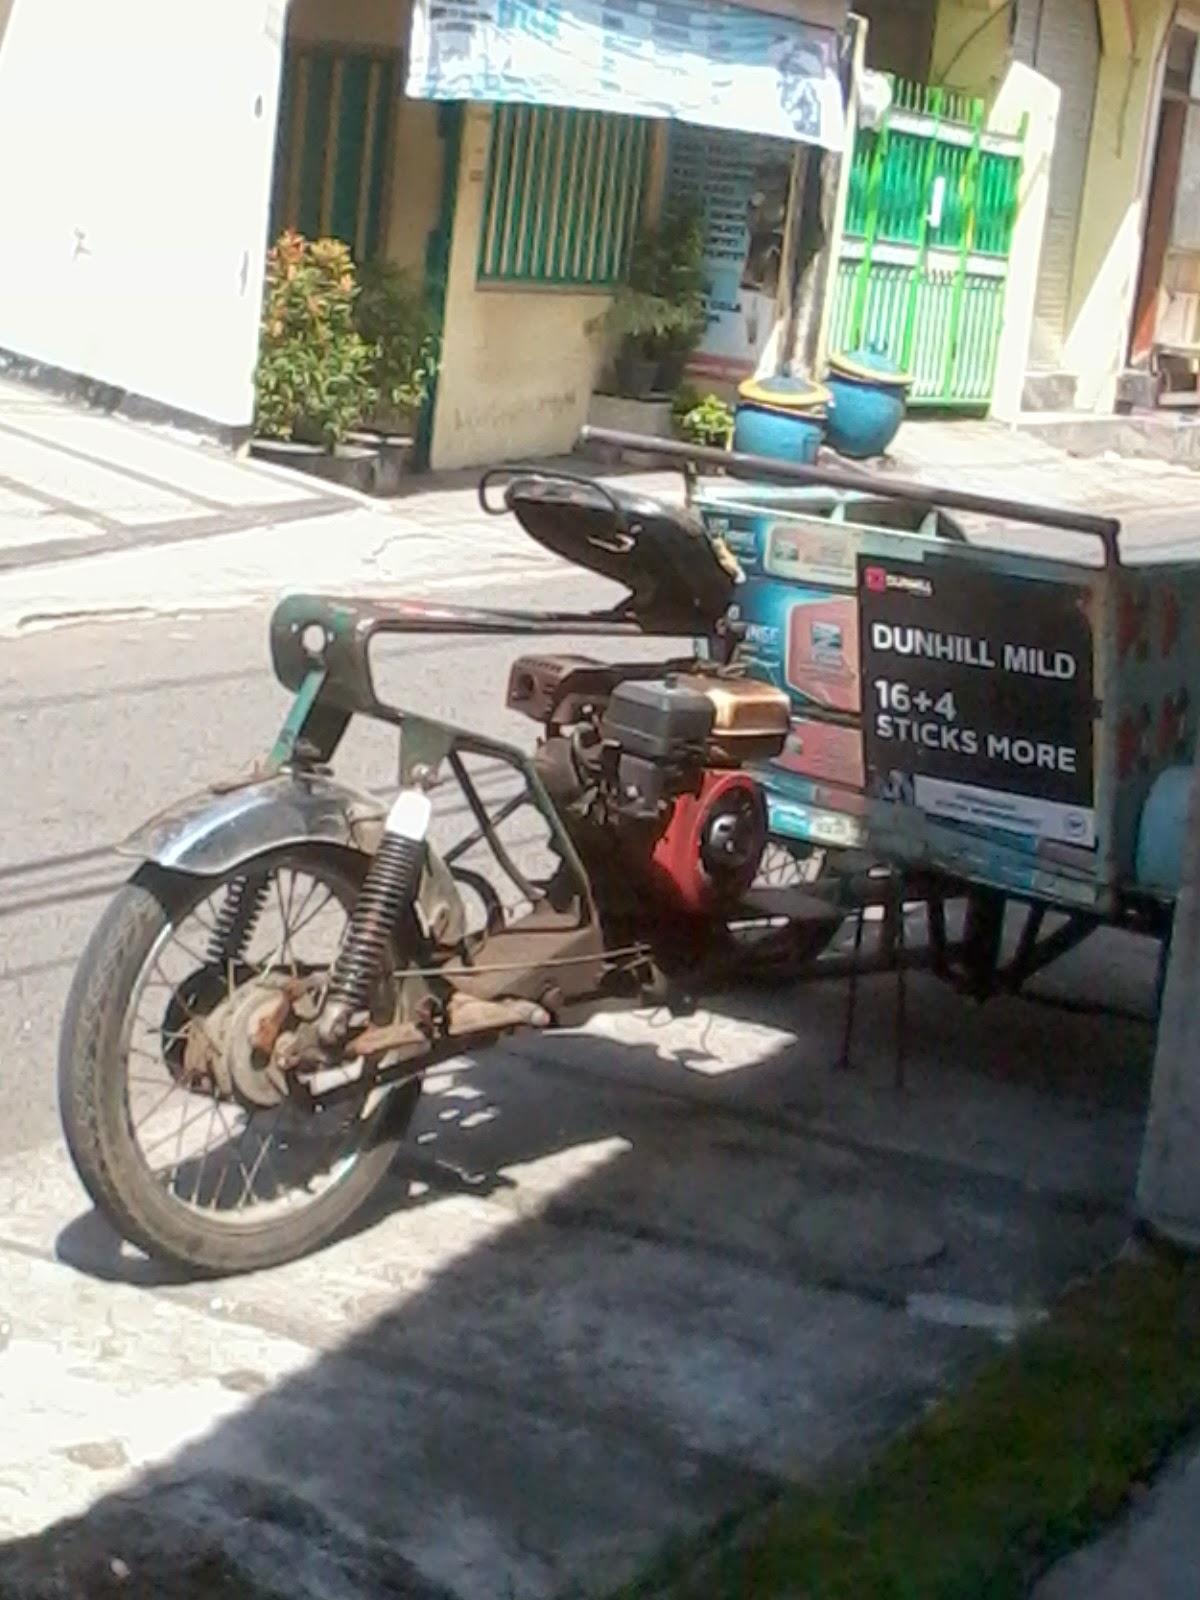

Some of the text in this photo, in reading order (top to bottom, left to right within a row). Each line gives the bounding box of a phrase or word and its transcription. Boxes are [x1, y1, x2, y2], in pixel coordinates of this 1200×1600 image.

[872, 623, 1076, 679] DUNHILL MILD
[874, 680, 957, 721] 16+4
[876, 715, 1077, 773] STICKS MORE
